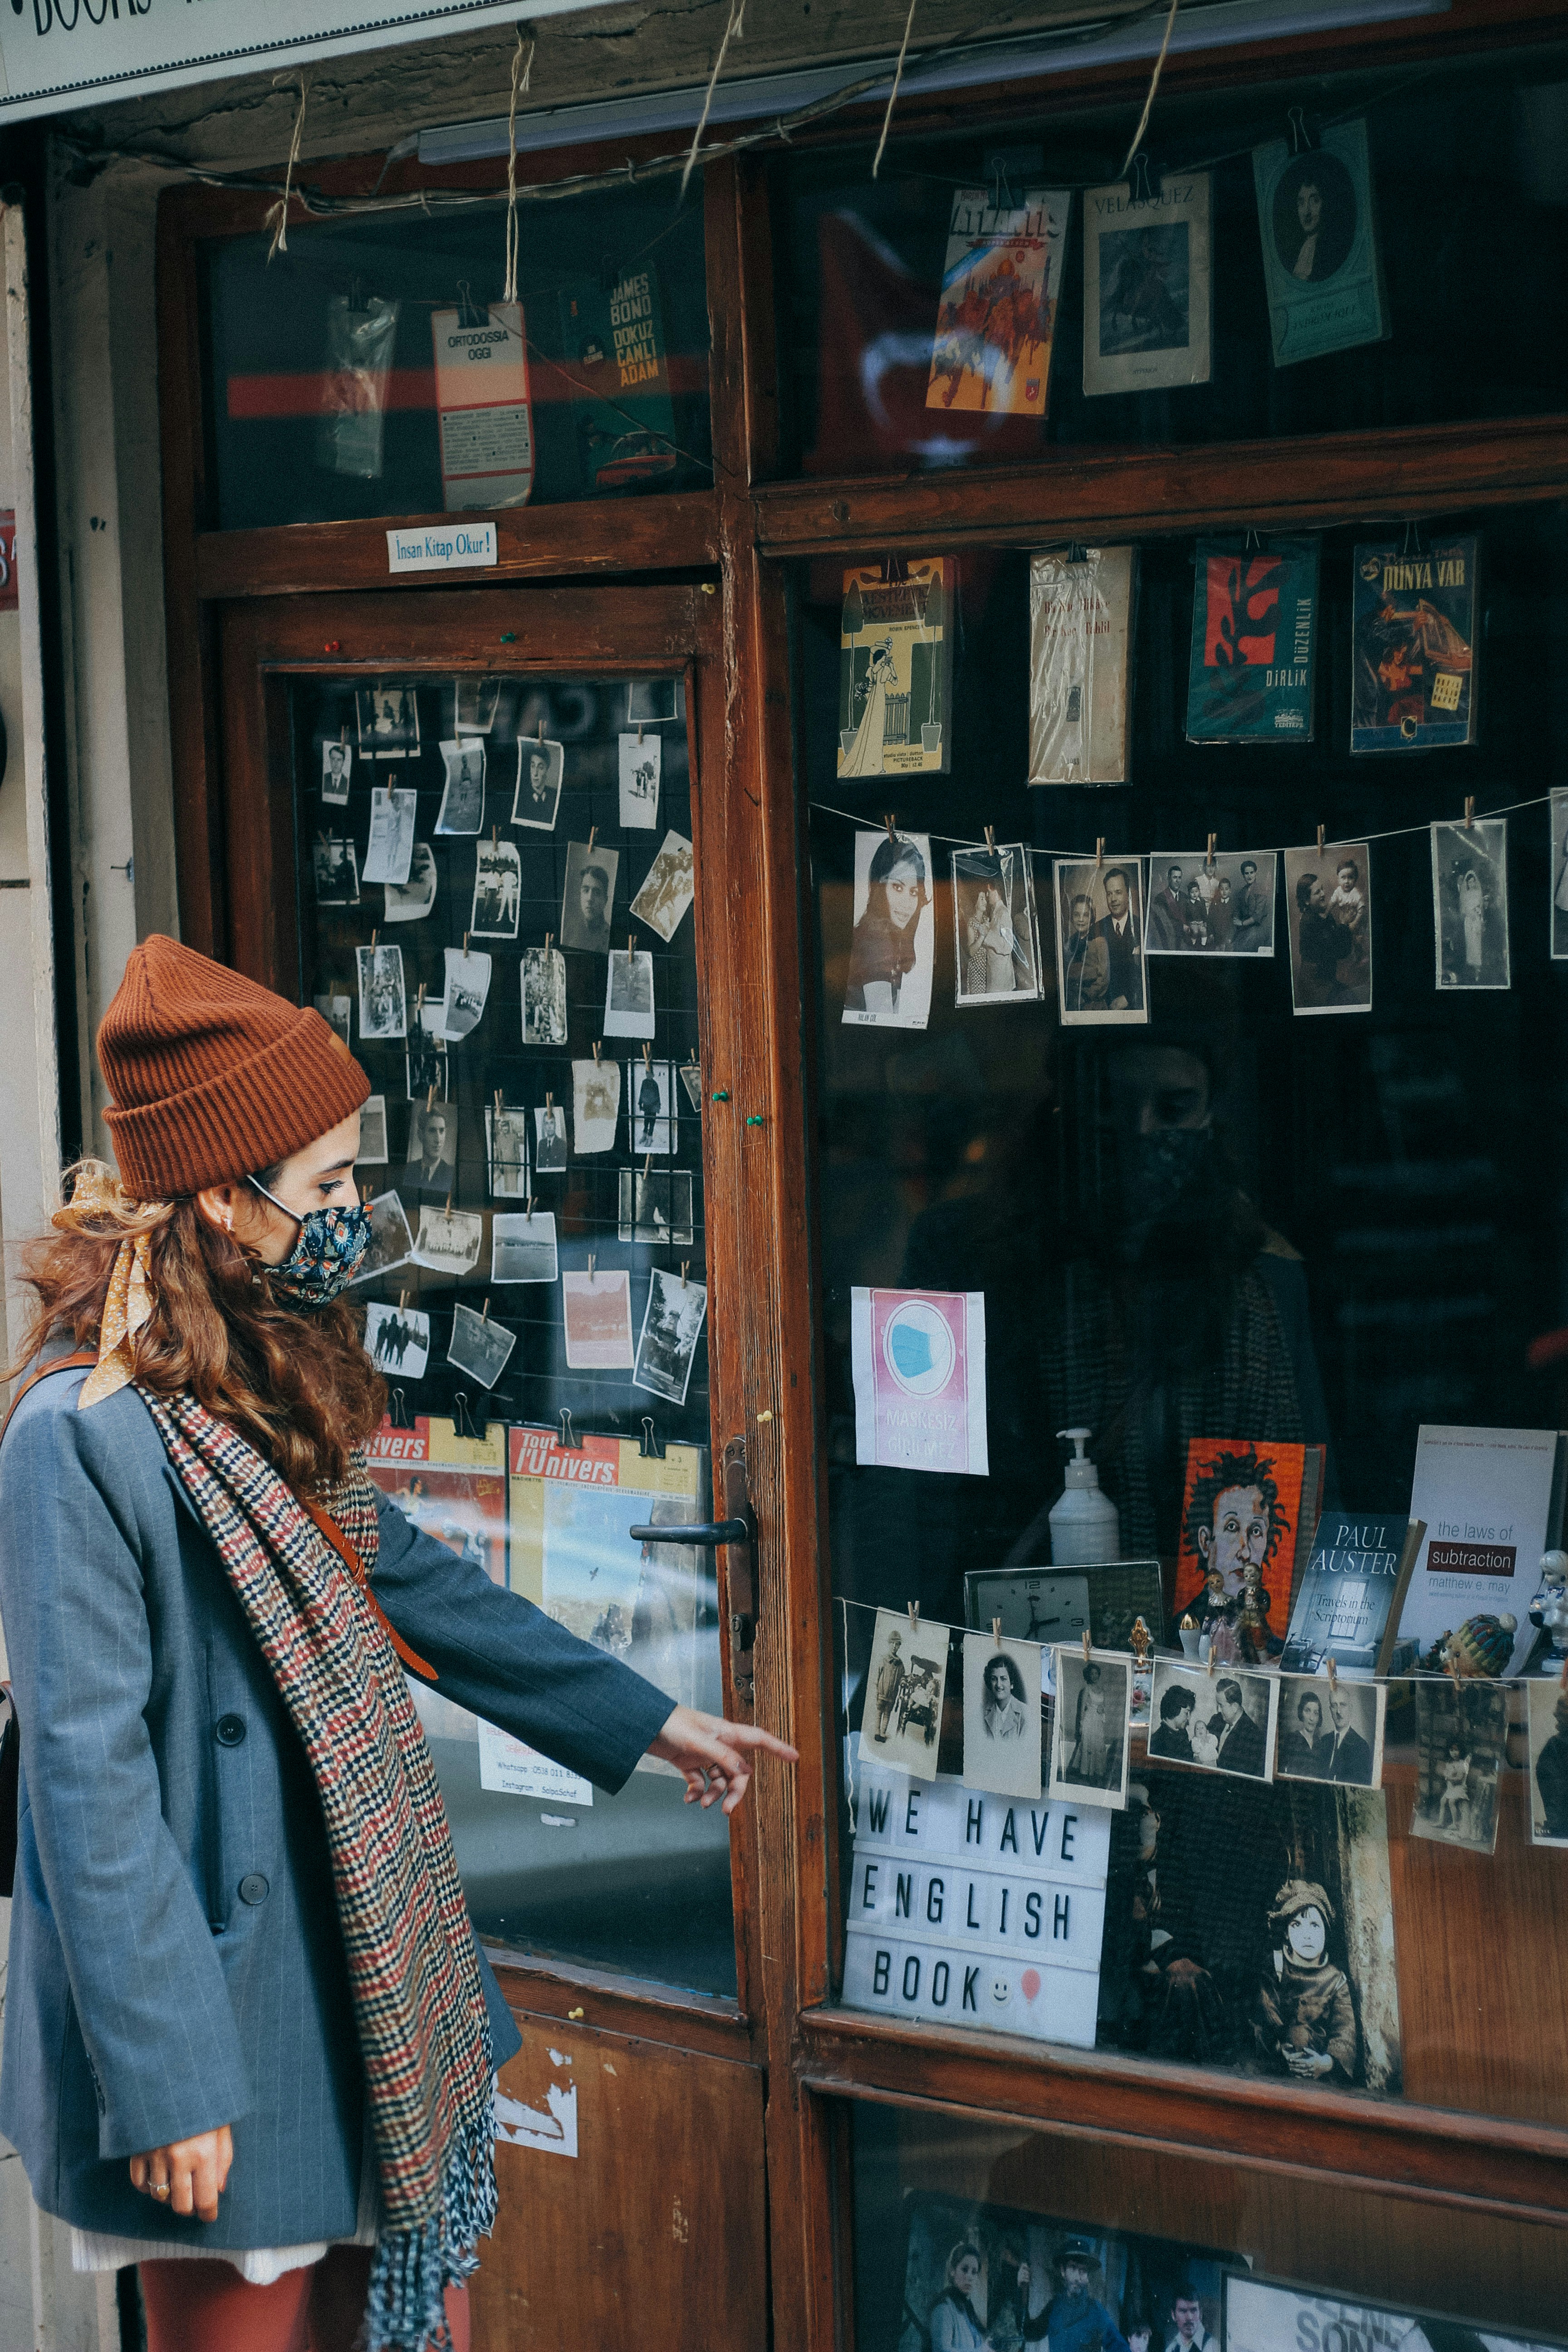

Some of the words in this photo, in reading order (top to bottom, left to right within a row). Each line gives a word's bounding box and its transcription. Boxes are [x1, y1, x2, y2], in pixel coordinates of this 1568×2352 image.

[1095, 185, 1194, 215] VELASQUEZ
[610, 273, 649, 305] JAMES
[610, 294, 652, 326] BOND
[447, 330, 509, 348] ORTODOSSIA
[612, 319, 654, 349] DOKUZ
[468, 347, 491, 361] OGGI
[616, 338, 657, 368] CANLI
[621, 358, 659, 388] ADAM
[396, 535, 422, 560] İnsan
[425, 536, 453, 562] Kitap
[1383, 560, 1433, 593] DÜNYA
[1436, 559, 1465, 587] VAR
[886, 1407, 959, 1432] MASKESİZ
[522, 1432, 558, 1451] Tout
[515, 1447, 616, 1484] l'Univers
[1334, 1524, 1387, 1549] PAUL
[1438, 1521, 1460, 1538] the
[1464, 1522, 1495, 1540] laws
[1499, 1524, 1514, 1541] of
[1311, 1548, 1397, 1576] AUSTER
[1432, 1548, 1511, 1569] subtraction
[1024, 1580, 1041, 1590] 12
[1428, 1577, 1474, 1590] matthew
[1475, 1581, 1485, 1591] e.
[1488, 1581, 1511, 1595] may
[1317, 1593, 1348, 1609] Travels
[1348, 1596, 1357, 1609] in
[1360, 1597, 1376, 1610] the
[1313, 1609, 1369, 1626] Scriptorium
[497, 1762, 528, 1774] Whatsapp
[502, 1779, 534, 1792] Instagram
[868, 1787, 922, 1836] WE
[965, 1798, 1078, 1862] HAVE
[862, 1864, 1070, 1941] ENGLISH
[872, 1950, 980, 2012] BOOK
